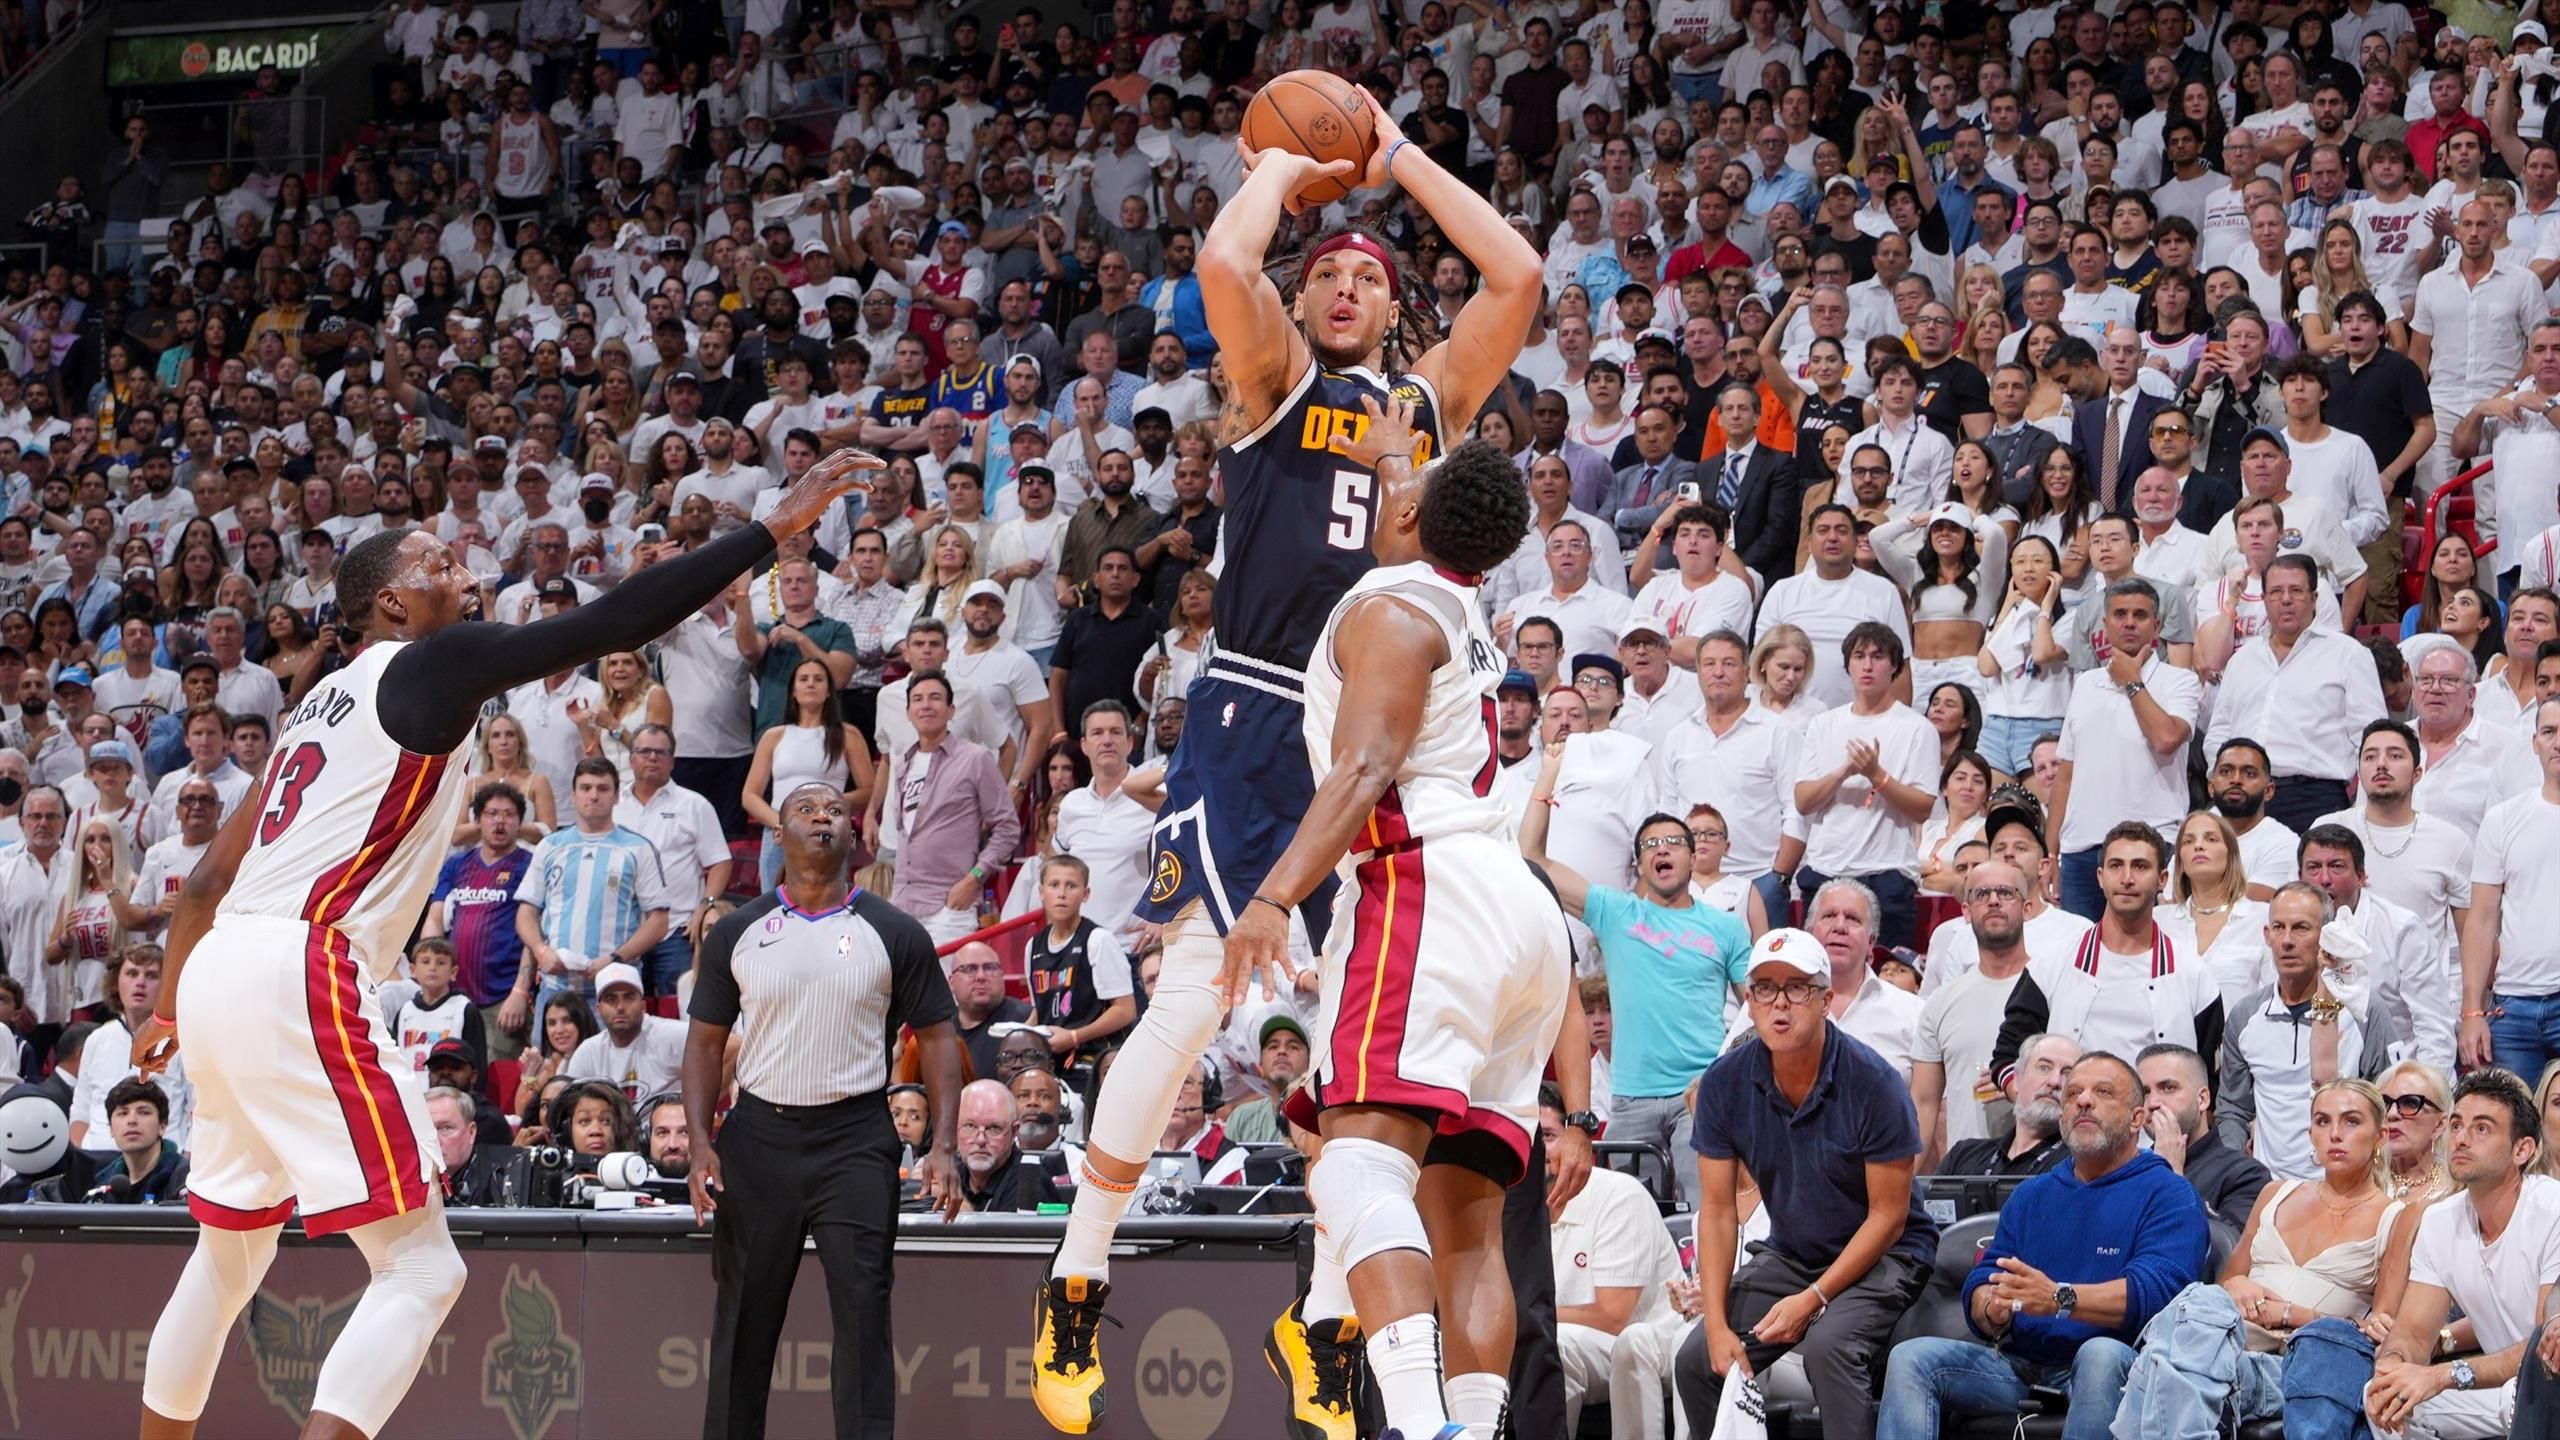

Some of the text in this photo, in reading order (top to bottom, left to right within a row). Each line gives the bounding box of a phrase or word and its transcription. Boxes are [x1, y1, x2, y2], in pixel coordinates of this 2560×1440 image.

[1673, 16, 1709, 26] MIAMI
[216, 33, 320, 73] BACARDÍ
[2375, 232, 2409, 254] 22
[929, 314, 947, 332] 3
[883, 398, 927, 414] DENVER
[972, 391, 986, 410] 2
[1327, 469, 1382, 550] 5
[246, 741, 327, 847] 13
[1142, 1353, 1226, 1398] abc
